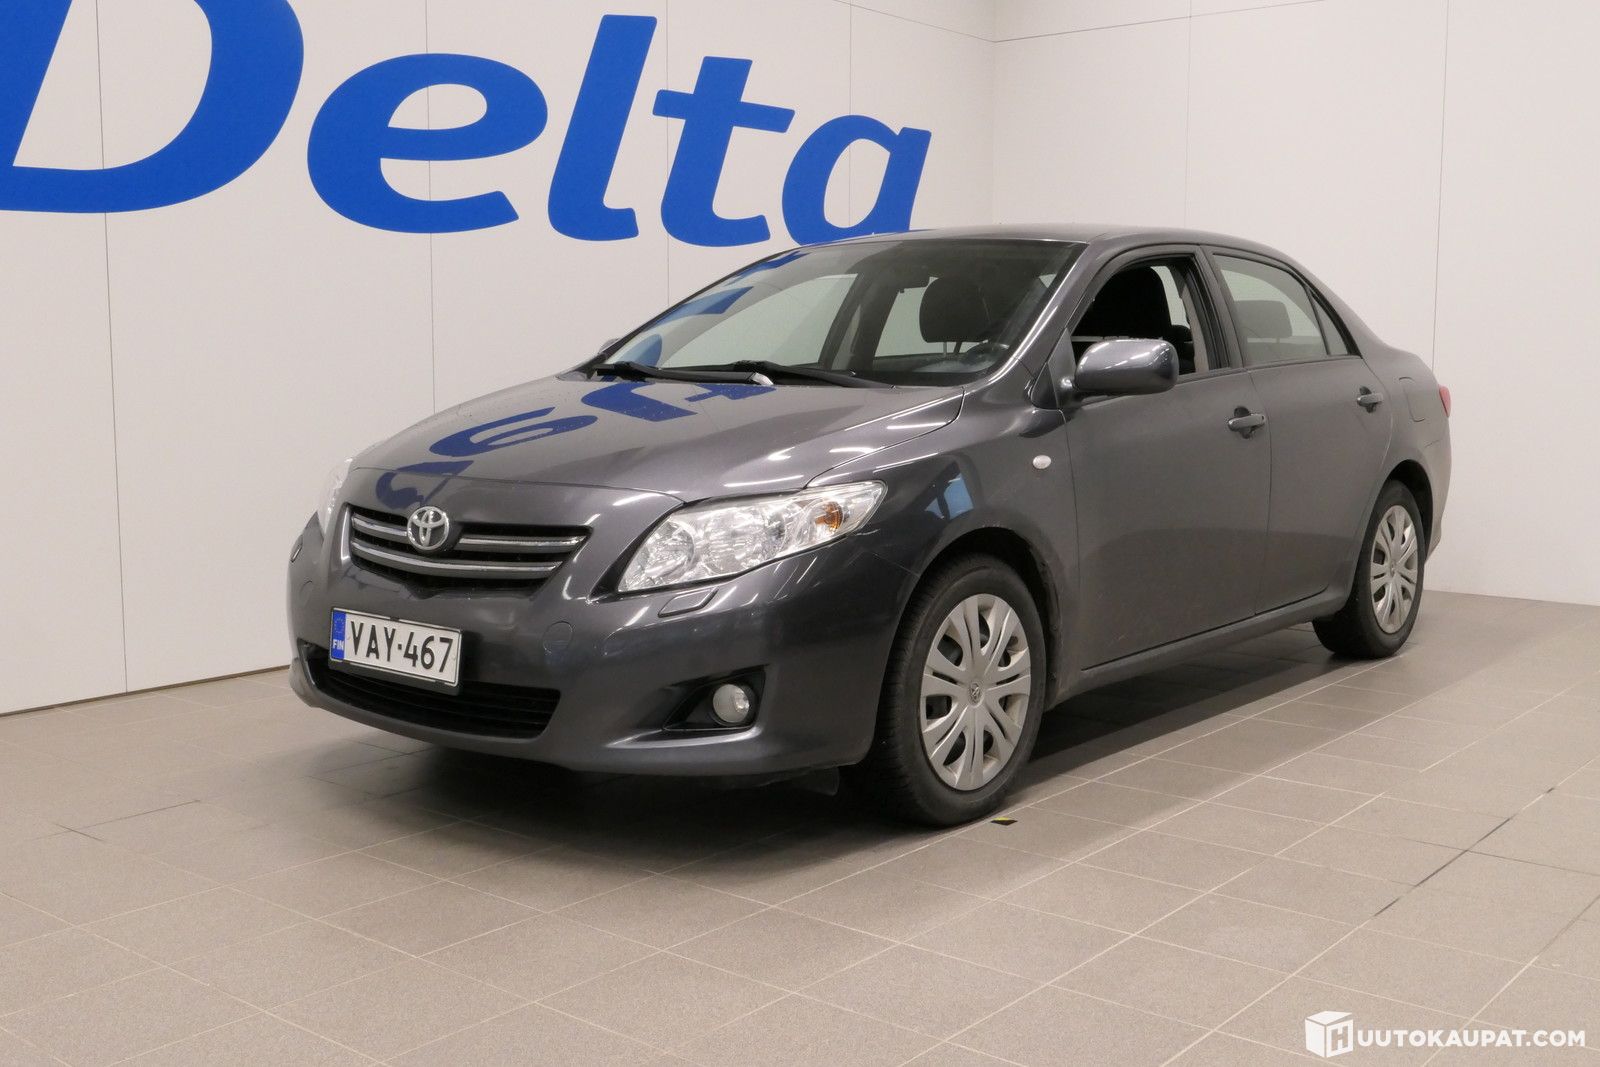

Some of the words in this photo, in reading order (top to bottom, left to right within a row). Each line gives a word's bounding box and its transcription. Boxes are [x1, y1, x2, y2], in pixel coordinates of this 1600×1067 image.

[0, 0, 931, 246] Delta
[333, 639, 345, 651] FIN
[351, 621, 453, 673] VAY-467
